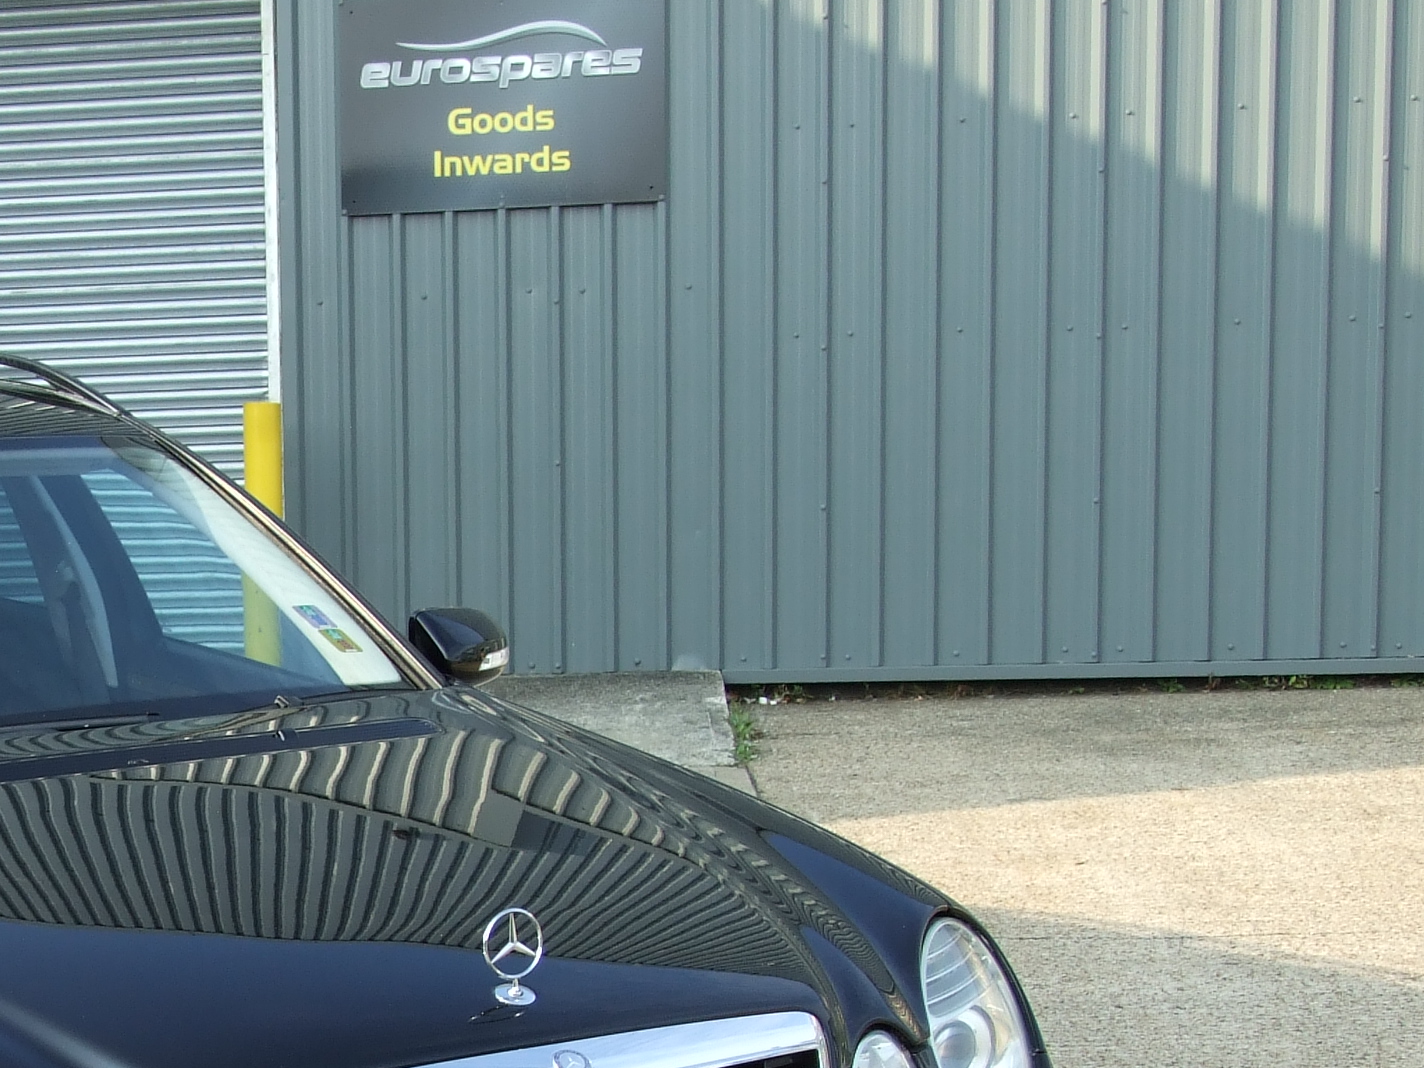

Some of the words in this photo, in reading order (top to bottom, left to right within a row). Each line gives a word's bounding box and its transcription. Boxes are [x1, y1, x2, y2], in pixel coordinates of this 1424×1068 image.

[360, 48, 643, 88] eurospares
[447, 104, 555, 135] Goods
[434, 145, 571, 177] Inwards
